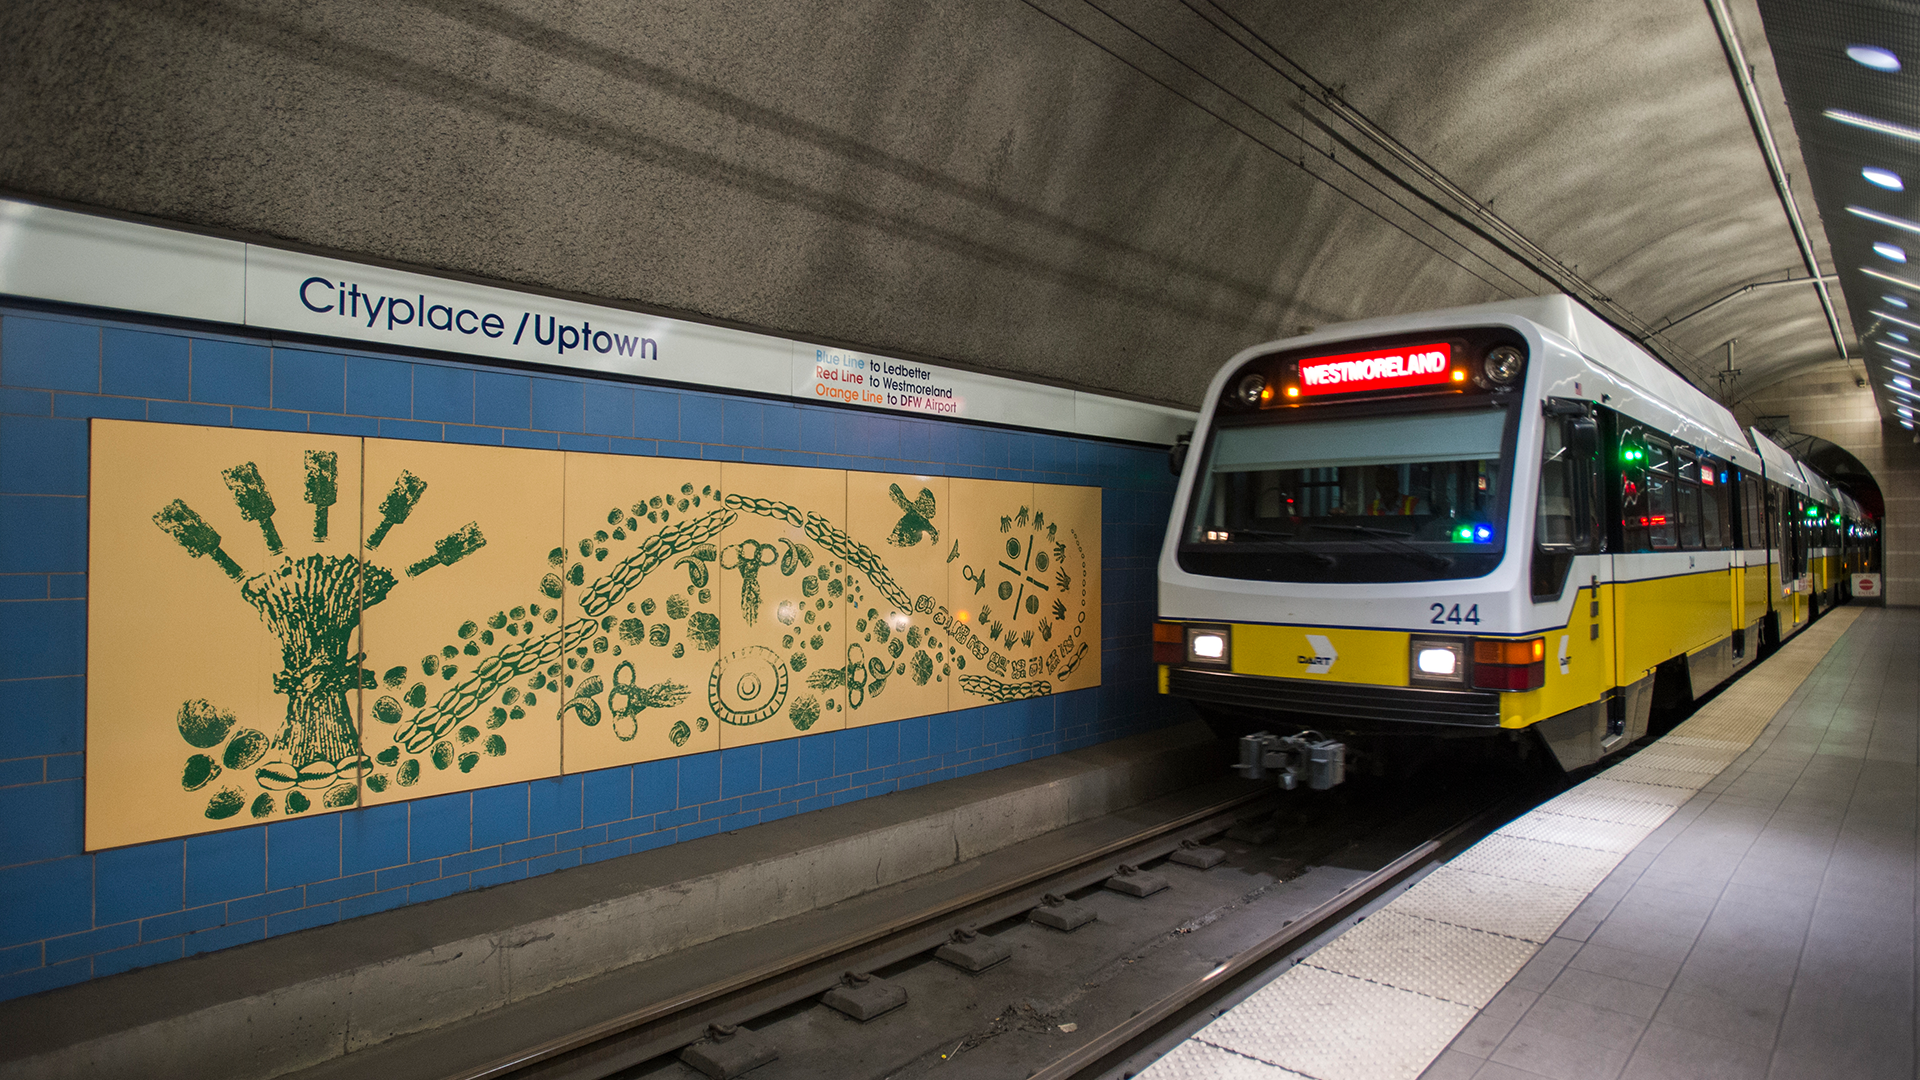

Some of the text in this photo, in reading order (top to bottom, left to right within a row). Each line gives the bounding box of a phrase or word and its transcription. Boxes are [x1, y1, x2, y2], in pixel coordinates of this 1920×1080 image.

[299, 276, 505, 338] Cityplace
[816, 349, 931, 381] Blue Line to Ledbetter
[1302, 351, 1446, 386] WESTMORELAND
[815, 382, 957, 414] Orange Line to DFW Airport
[816, 365, 952, 399] Red Line to Westmoreland
[1430, 602, 1481, 625] 244
[1297, 655, 1332, 666] DART
